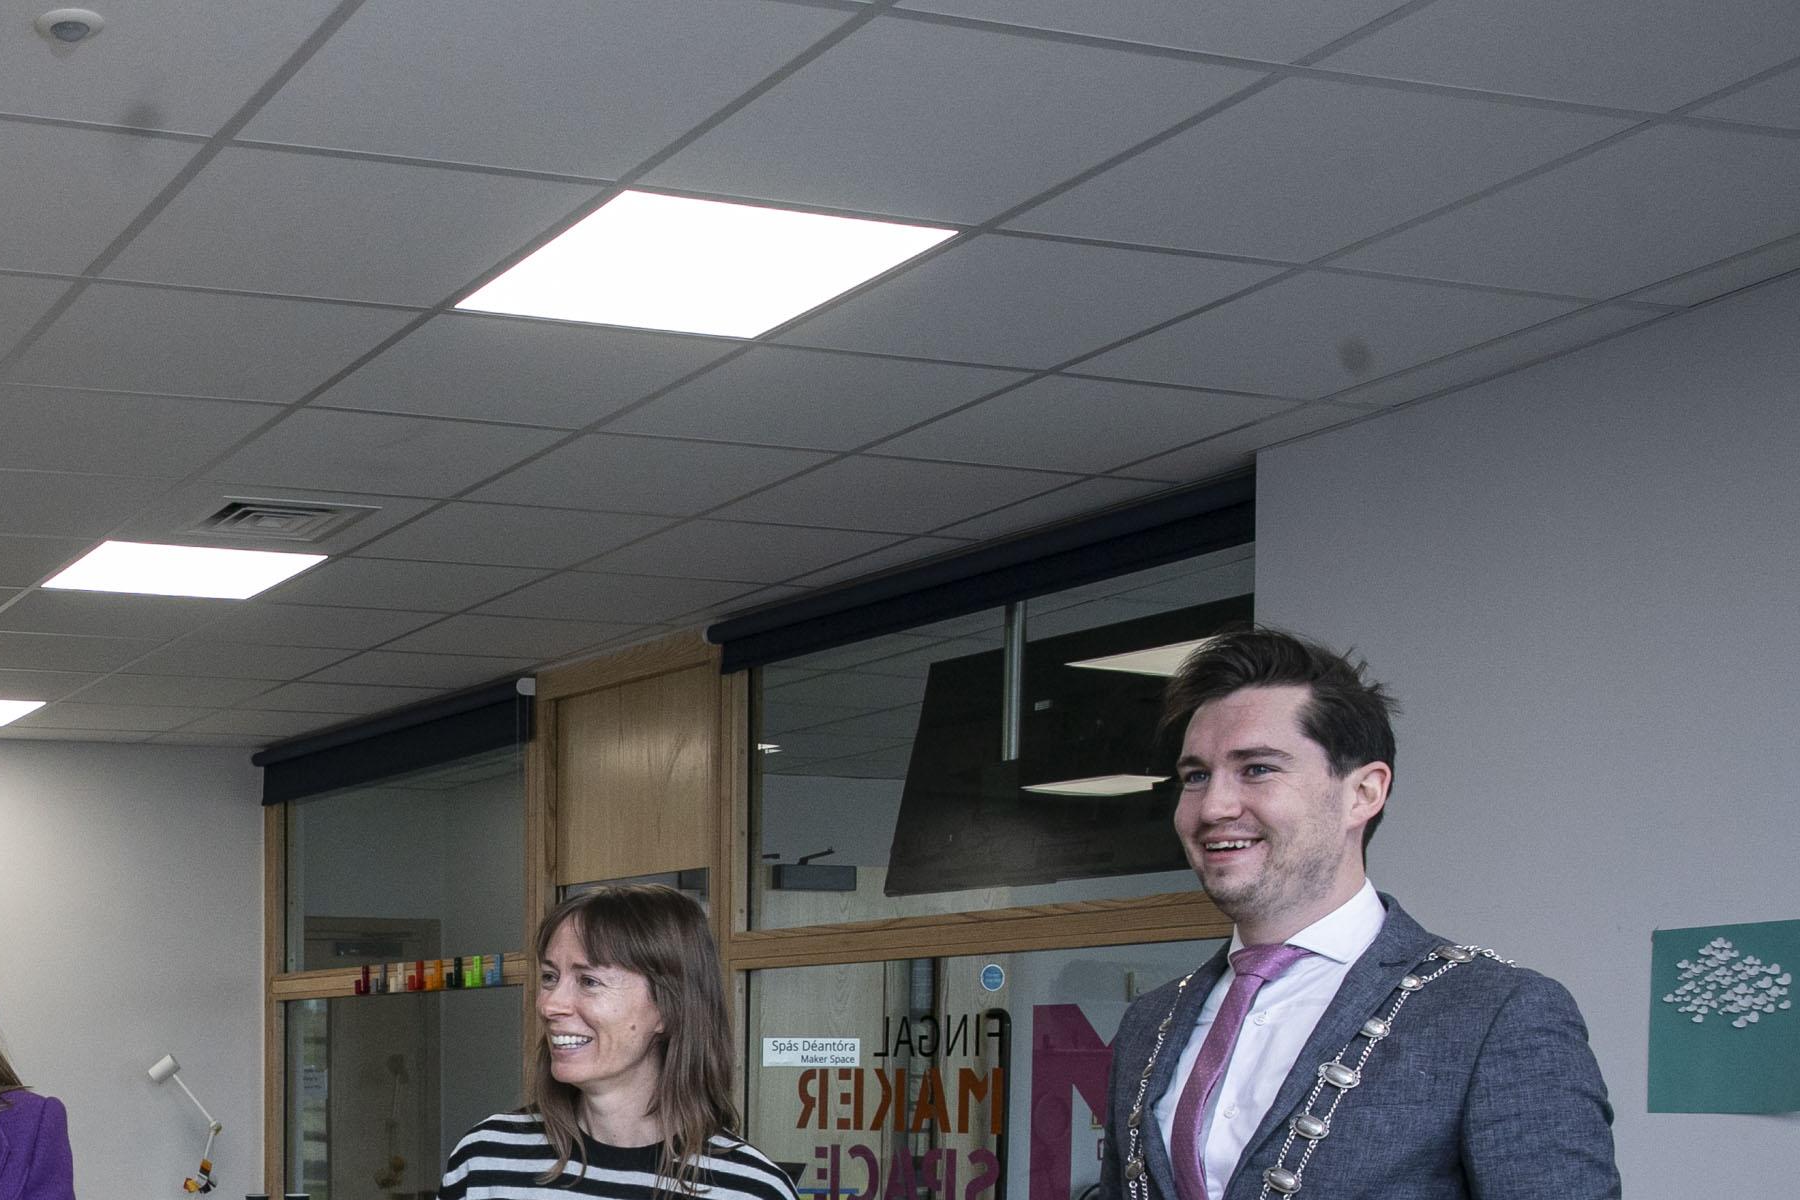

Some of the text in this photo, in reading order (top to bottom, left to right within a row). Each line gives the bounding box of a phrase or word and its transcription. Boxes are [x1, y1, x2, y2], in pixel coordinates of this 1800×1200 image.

[771, 1039, 856, 1053] Spás Déantóra
[801, 1054, 856, 1065] Maker Space
